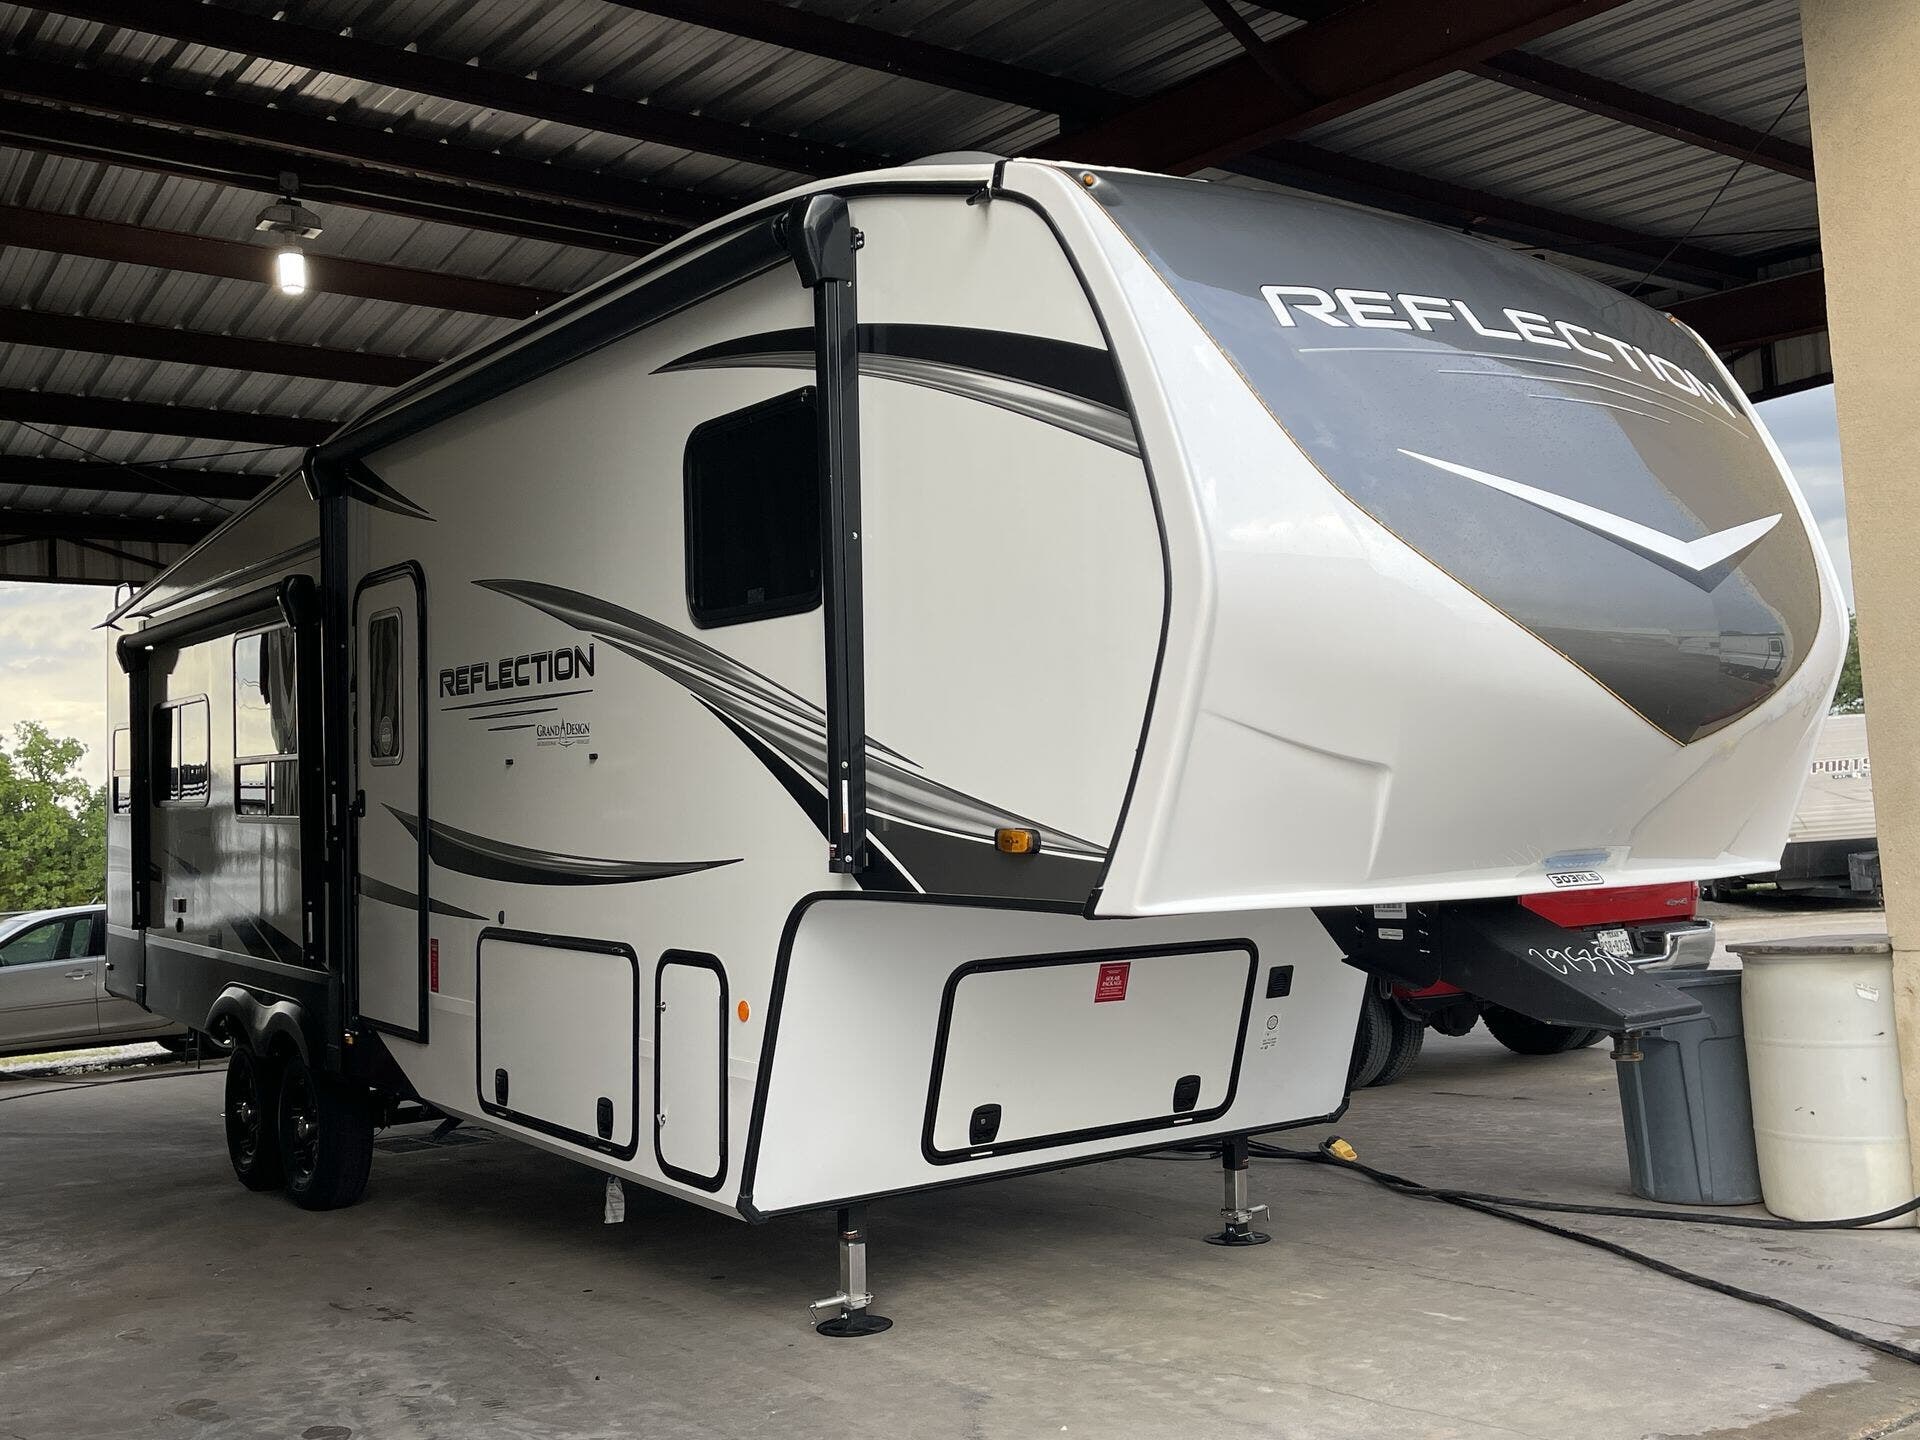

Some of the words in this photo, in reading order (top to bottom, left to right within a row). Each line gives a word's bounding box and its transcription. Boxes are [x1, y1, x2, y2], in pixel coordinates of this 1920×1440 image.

[1260, 284, 1737, 419] REFLECTION
[439, 642, 595, 698] REFLECTION
[536, 724, 560, 737] GRAND
[566, 722, 590, 735] DESIGN
[1551, 872, 1600, 884] 303RLS
